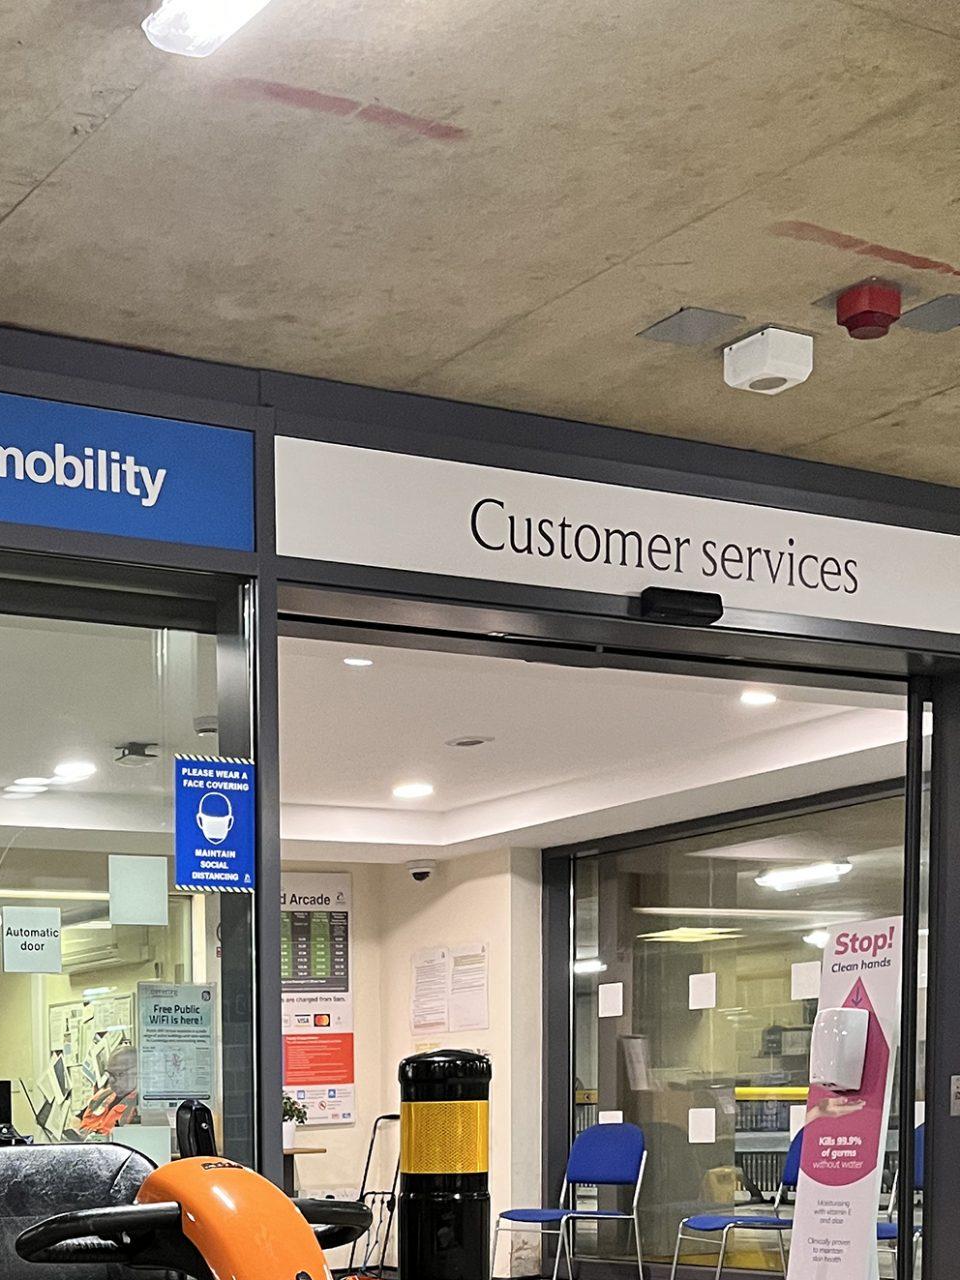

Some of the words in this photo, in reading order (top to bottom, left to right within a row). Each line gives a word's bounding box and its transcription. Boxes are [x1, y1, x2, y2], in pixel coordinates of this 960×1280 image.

[470, 498, 691, 574] Customer
[701, 538, 859, 594] services
[182, 768, 214, 777] PLEASE
[216, 770, 240, 779] WEAR
[241, 772, 248, 780] A
[183, 779, 205, 789] FACE
[206, 781, 249, 791] COVERING
[195, 849, 236, 859] MAINTAIN
[200, 860, 229, 869] SOCIAL
[192, 872, 239, 881] DISTANCING
[290, 893, 331, 905] Arcade
[6, 927, 60, 938] Automatic
[20, 941, 45, 951] door
[834, 926, 895, 957] Stop!
[831, 962, 859, 973] Clean
[860, 957, 891, 970] hands
[153, 1004, 173, 1014] Free
[174, 1004, 201, 1014] Public
[171, 1016, 179, 1025] is
[819, 1136, 836, 1146] Kills
[821, 1147, 831, 1157] of
[831, 1149, 857, 1160] germs
[812, 1160, 840, 1169] without
[841, 1160, 864, 1169] water
